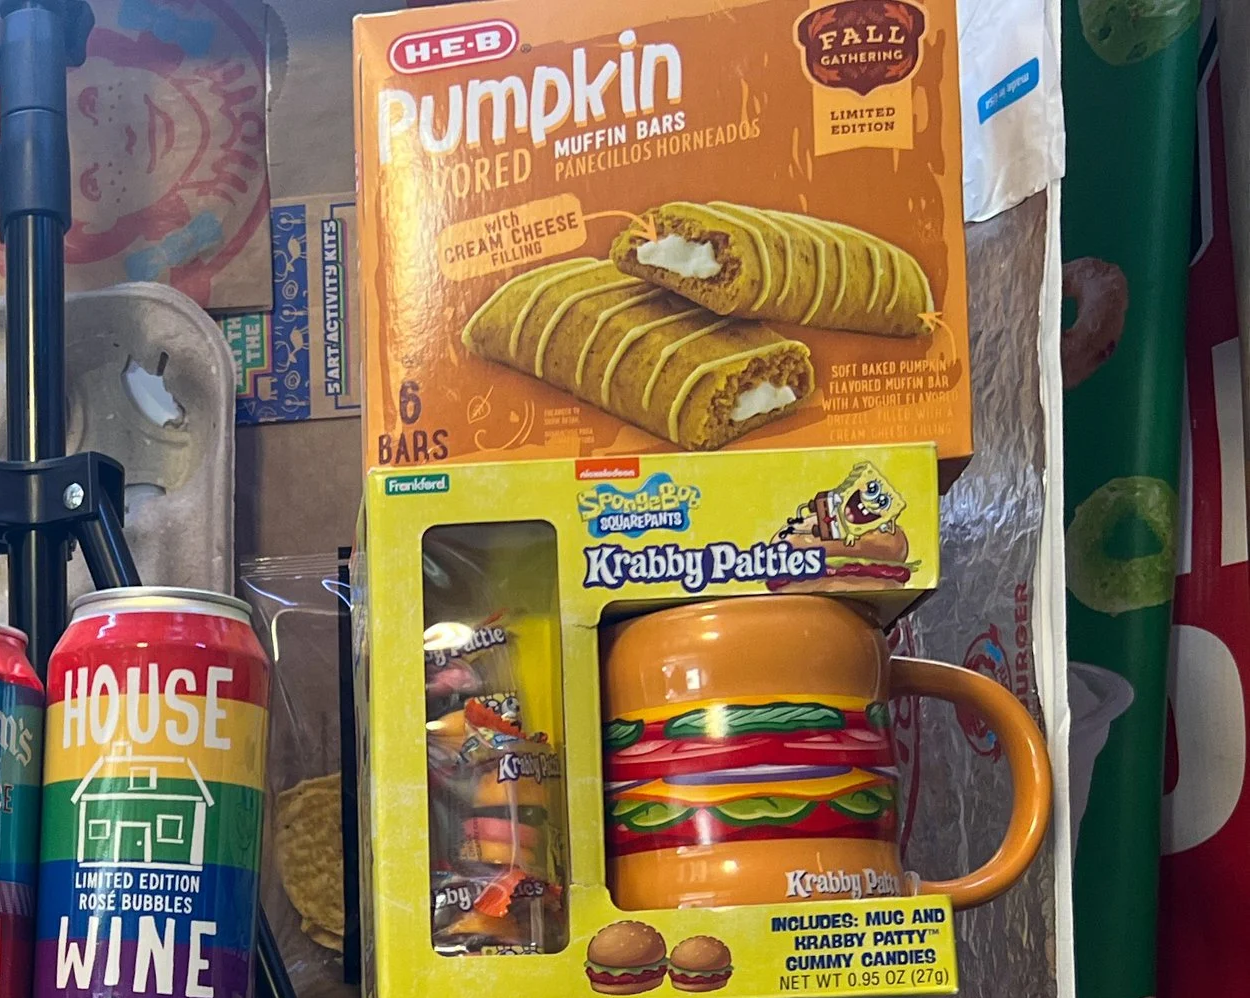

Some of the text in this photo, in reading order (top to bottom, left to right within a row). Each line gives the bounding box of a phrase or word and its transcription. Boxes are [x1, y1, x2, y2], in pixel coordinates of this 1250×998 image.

[403, 30, 502, 64] H-E-B
[818, 25, 906, 50] FALL
[819, 47, 904, 66] GATHERING
[378, 29, 683, 165] Pumpkin
[830, 105, 896, 122] LIMITED
[554, 111, 686, 158] MUFFIN BARS
[830, 120, 896, 135] EDITION
[554, 118, 761, 181] PANECILLOS HORNEADOS
[484, 211, 520, 233] with
[444, 212, 579, 264] CREAM CHEESE
[491, 241, 543, 267] FILLING
[323, 220, 341, 394] 5 ART ACTIVITY KITS
[245, 323, 262, 364] THE
[831, 359, 947, 378] SOFT BAKED PUMPKIN
[829, 375, 949, 394] FLAVORED MUFFIN BAR
[399, 381, 422, 426] 6
[378, 429, 448, 466] BARS
[577, 483, 701, 521] SpongeBob
[599, 512, 683, 531] SQUAREPANTS
[585, 540, 823, 589] Krabby Patties
[62, 662, 234, 751] HOUSE
[75, 872, 200, 893] LIMITED EDITION
[785, 869, 862, 899] Krabby
[78, 889, 192, 914] ROSÉ BUBBLES
[771, 908, 945, 932] INCLUDES: MUG AND
[795, 933, 865, 951] KRABBY
[56, 915, 217, 998] WINE
[786, 948, 936, 971] GUMMY CANDIES
[779, 967, 949, 991] NET WT 0.95 OZ (27g)
